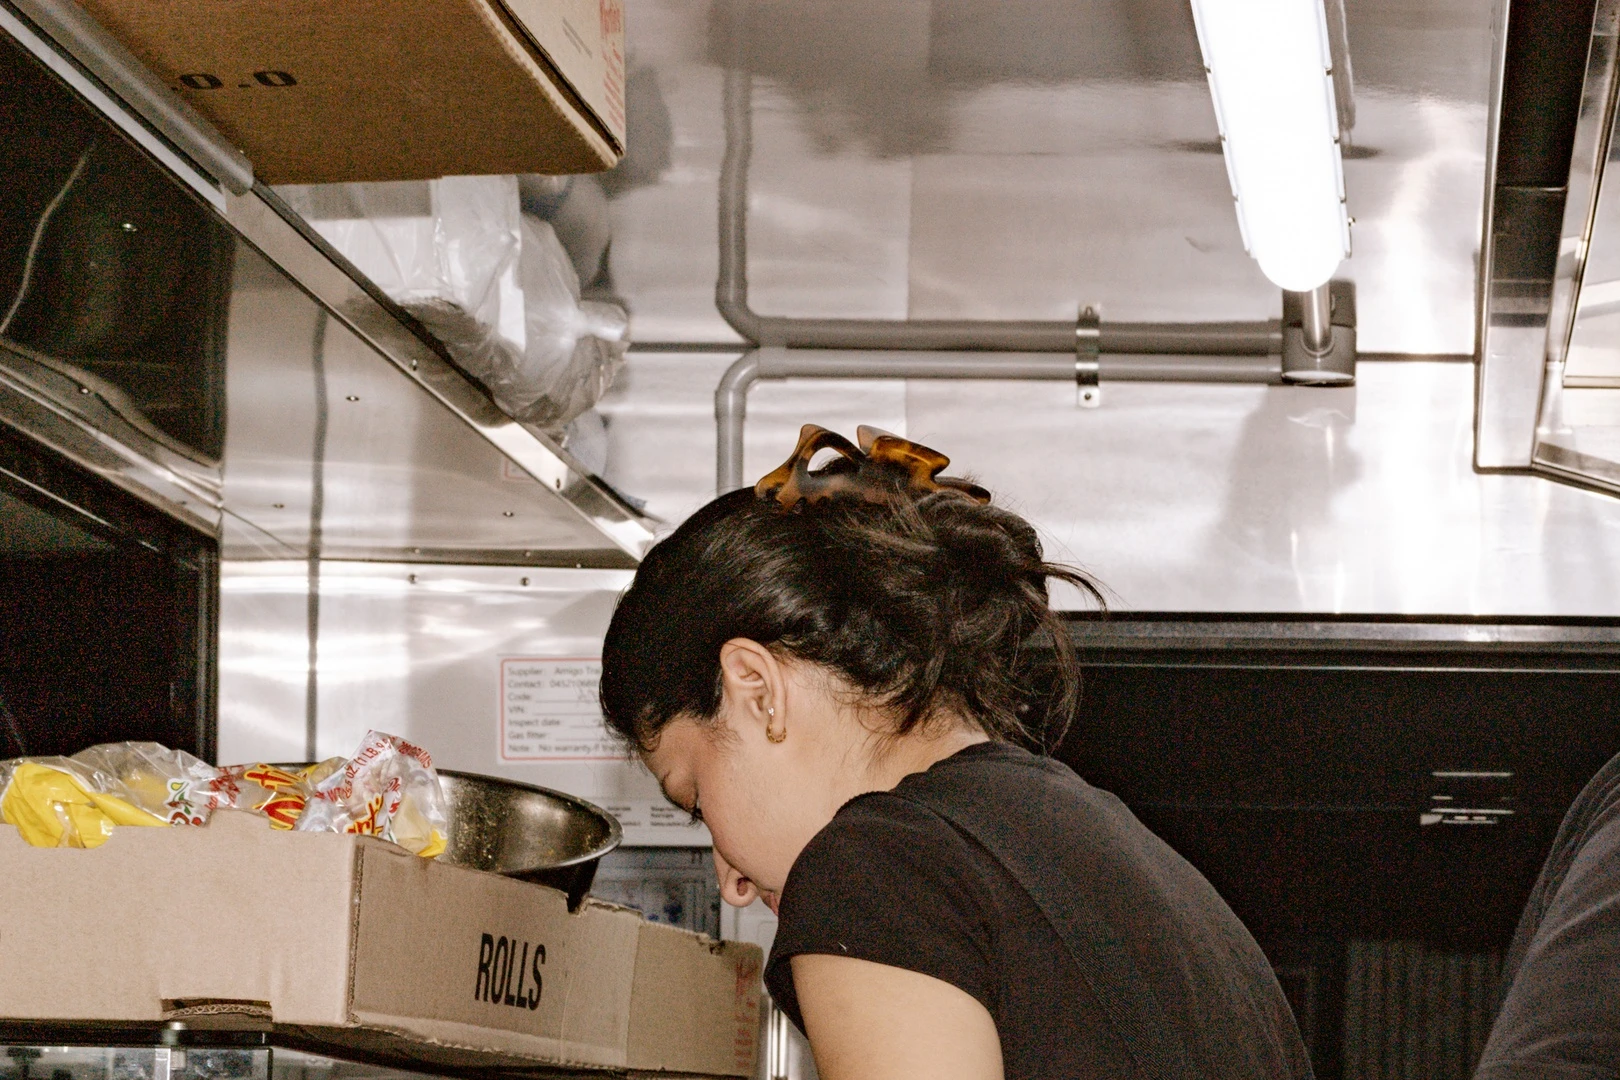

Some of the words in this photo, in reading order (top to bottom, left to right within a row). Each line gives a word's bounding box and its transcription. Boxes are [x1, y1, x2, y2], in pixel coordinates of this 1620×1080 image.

[508, 679, 545, 689] Contact:
[508, 718, 539, 727] Inspect
[508, 731, 524, 739] Gas
[538, 744, 552, 752] No
[474, 932, 547, 1011] ROLLS
